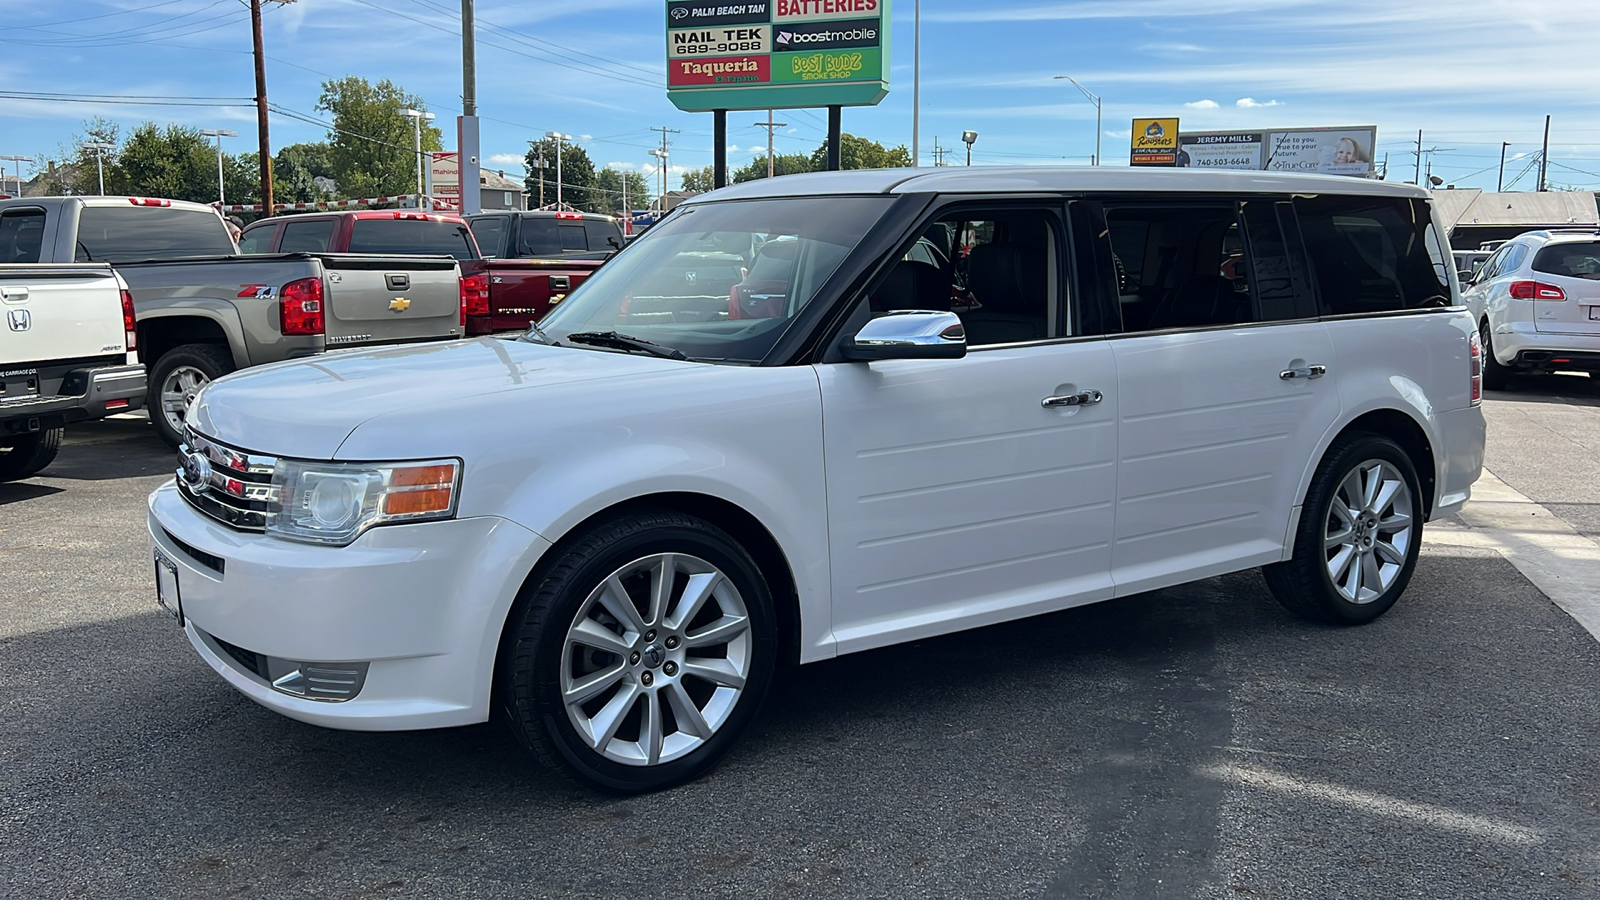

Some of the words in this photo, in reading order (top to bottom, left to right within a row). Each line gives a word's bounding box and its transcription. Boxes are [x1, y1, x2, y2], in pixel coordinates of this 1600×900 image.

[692, 8, 715, 17] PALM
[717, 5, 746, 16] BEACH
[748, 3, 765, 14] TAN
[777, 0, 877, 16] BATTERIES
[674, 31, 716, 44] NAIL
[723, 28, 762, 41] TEK
[676, 41, 761, 54] 689-9088
[829, 71, 851, 79] SHOP
[1136, 136, 1173, 147] Roosters
[1197, 136, 1228, 144] JEREMY
[1229, 135, 1253, 143] MILLS
